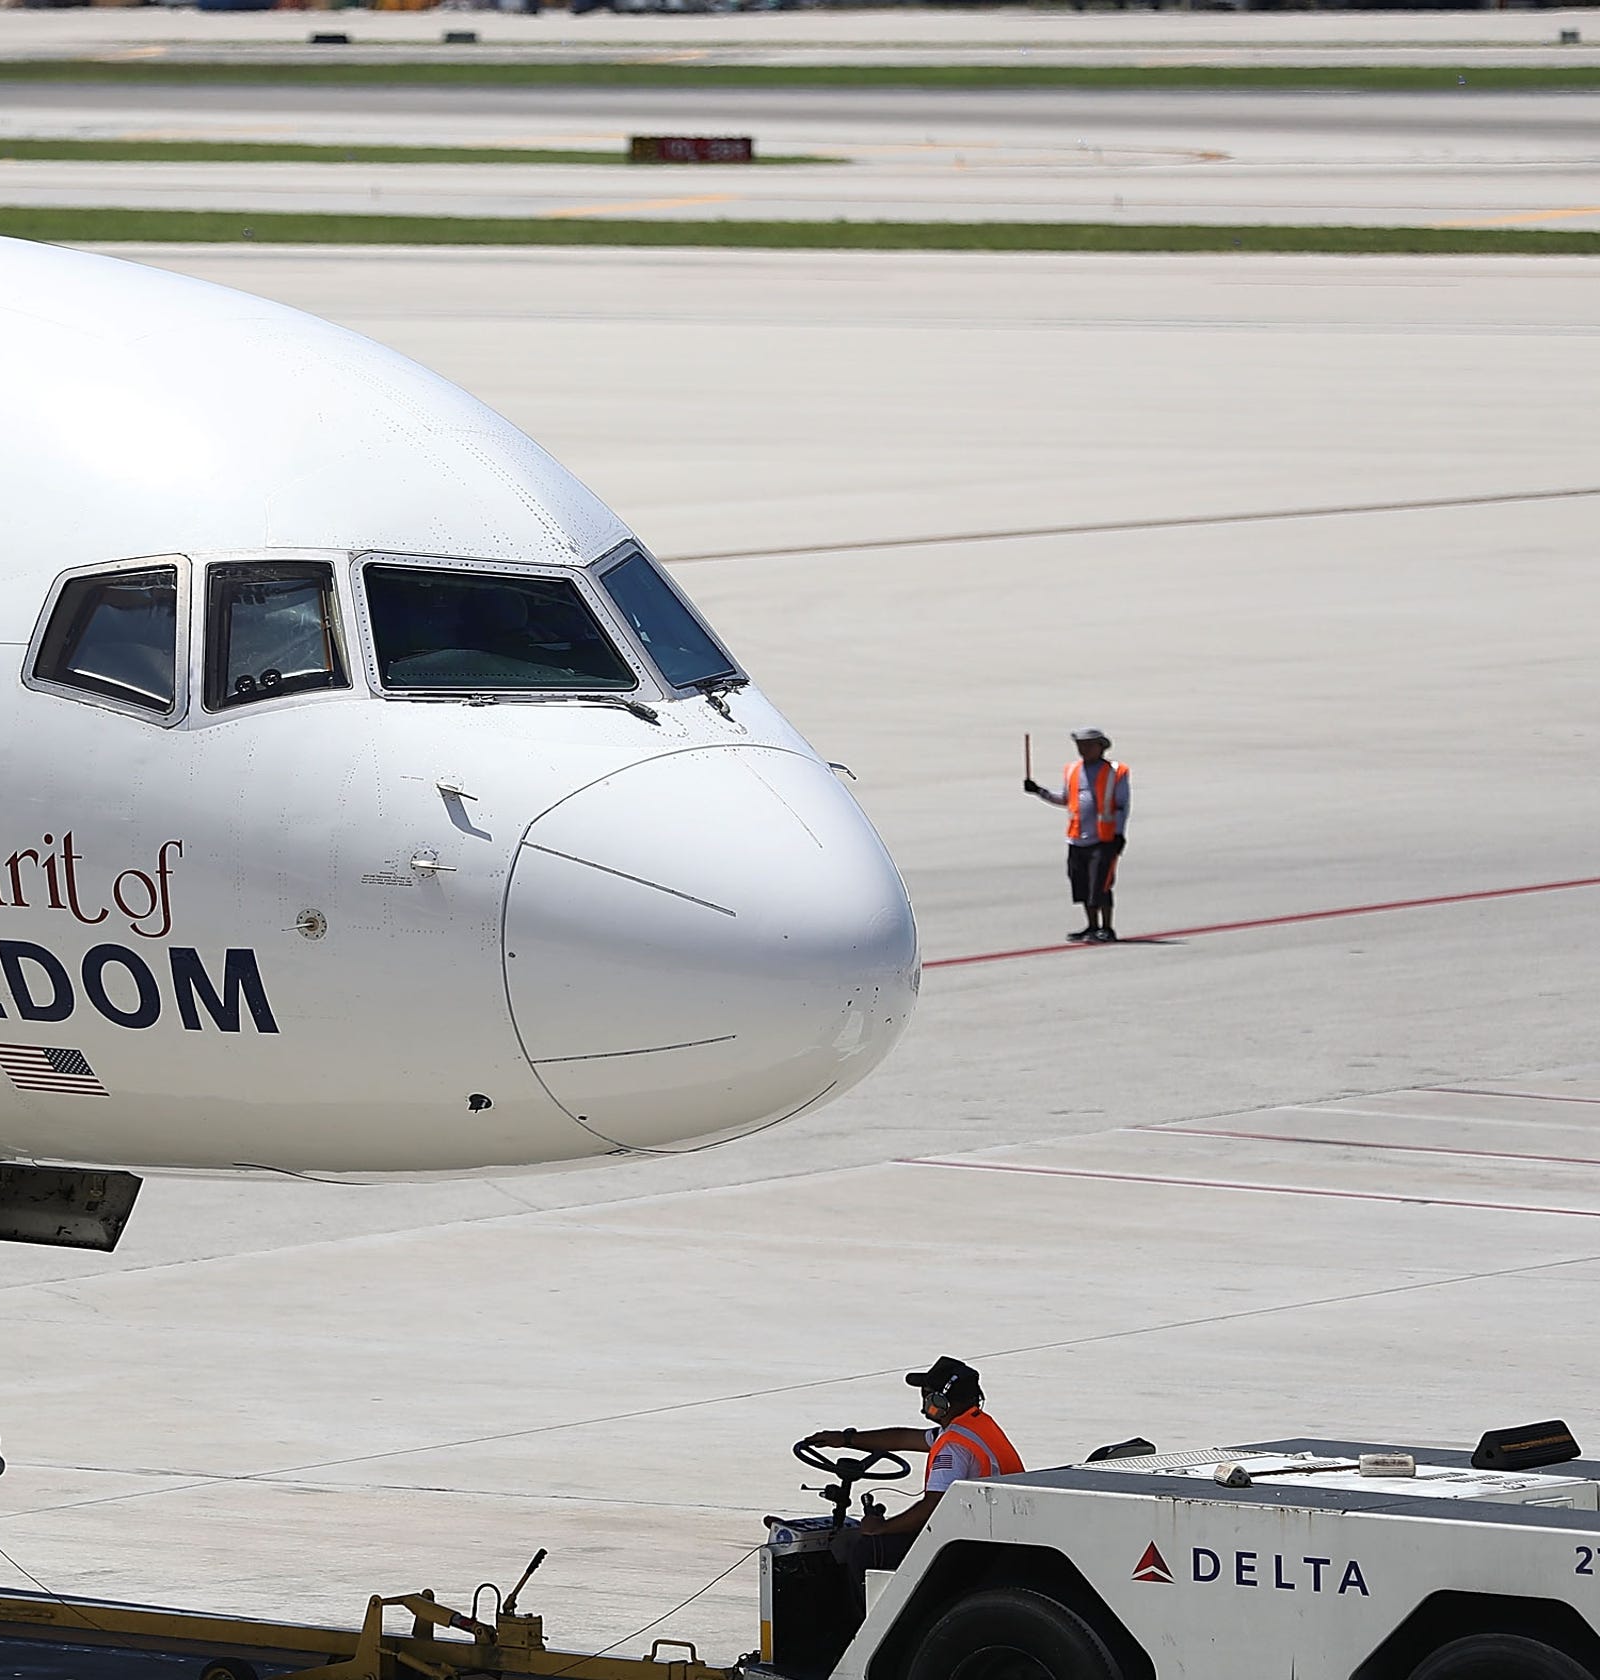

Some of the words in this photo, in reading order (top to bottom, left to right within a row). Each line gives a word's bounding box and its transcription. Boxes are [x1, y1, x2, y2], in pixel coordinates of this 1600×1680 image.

[113, 839, 184, 939] of
[1192, 1547, 1370, 1597] DELTA
[1575, 1546, 1600, 1575] 2
